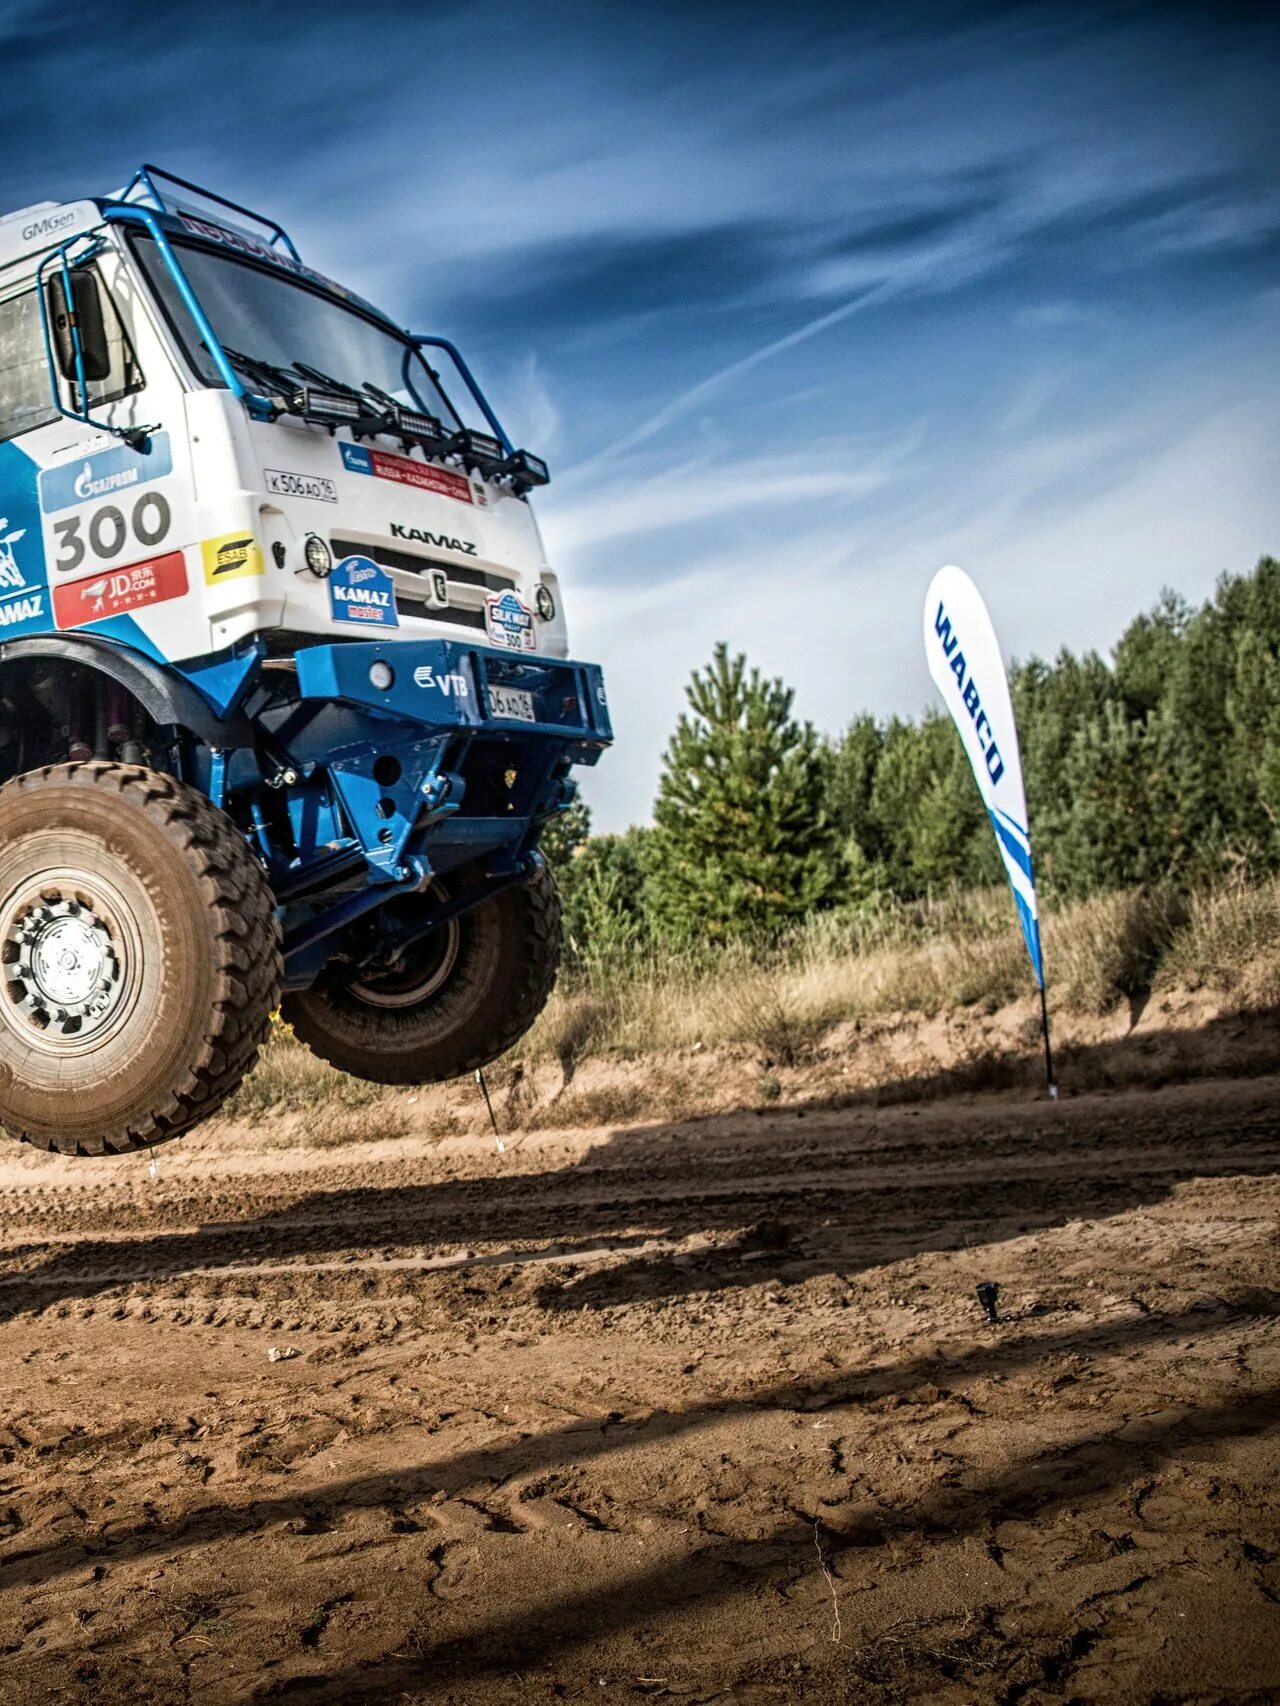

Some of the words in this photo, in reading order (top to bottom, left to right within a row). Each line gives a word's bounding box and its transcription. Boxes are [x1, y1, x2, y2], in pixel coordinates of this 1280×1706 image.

[53, 491, 171, 572] 300
[390, 523, 477, 556] KAMAZ
[217, 548, 247, 564] ESAB
[333, 586, 390, 607] KAMAZ
[348, 605, 383, 620] master
[506, 633, 521, 648] 300
[435, 674, 468, 697] VTB
[935, 600, 1005, 786] WABCO
